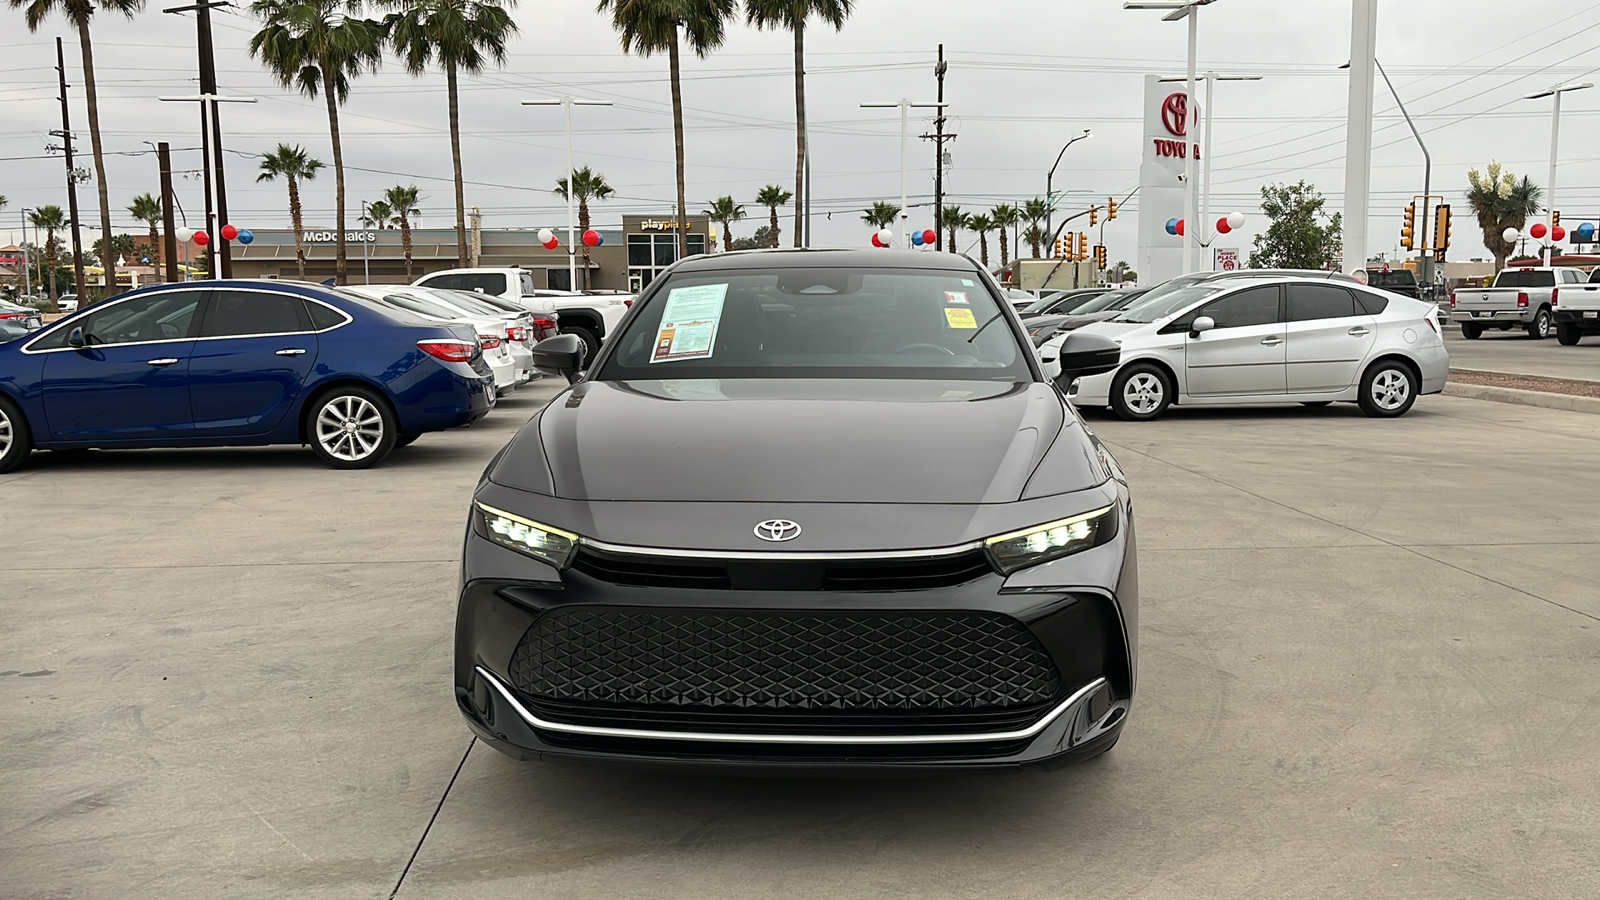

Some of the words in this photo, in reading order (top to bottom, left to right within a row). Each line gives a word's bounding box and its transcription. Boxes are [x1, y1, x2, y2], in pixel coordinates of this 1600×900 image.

[1153, 139, 1201, 160] TOYOA
[641, 219, 691, 230] playplae
[303, 231, 376, 242] McDoald's
